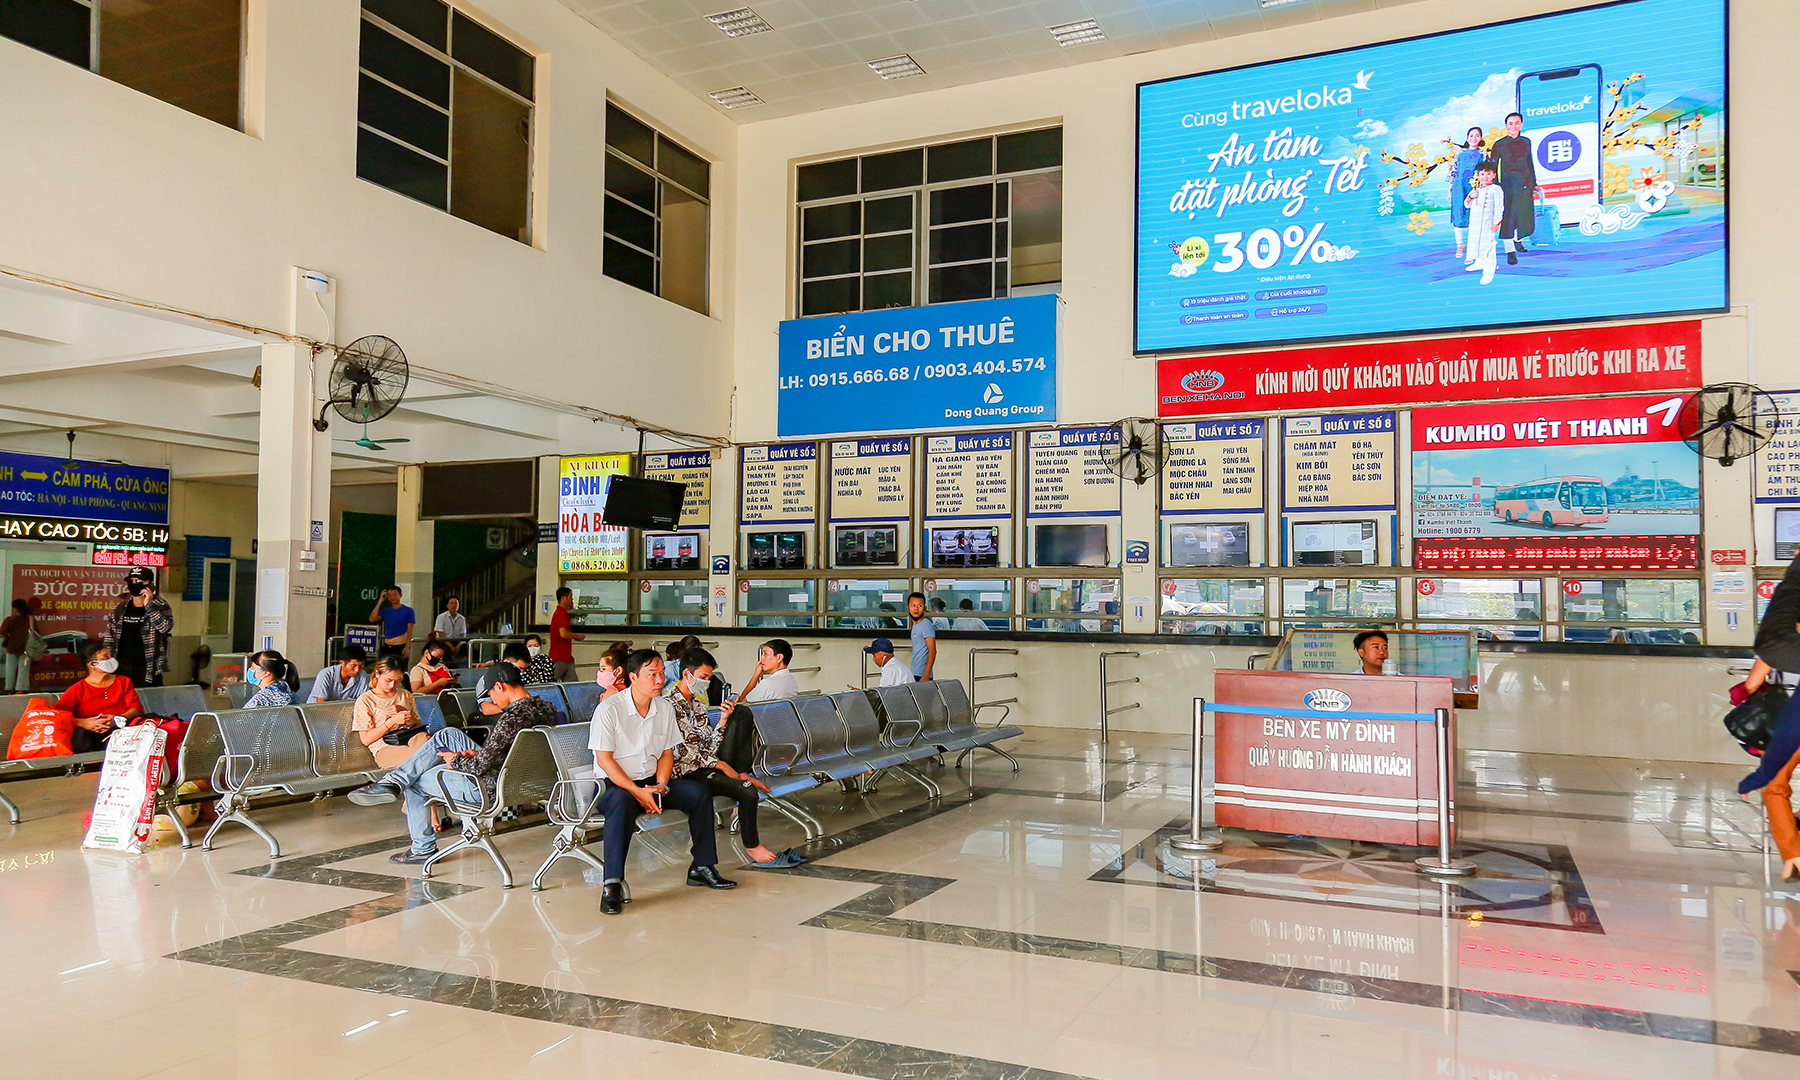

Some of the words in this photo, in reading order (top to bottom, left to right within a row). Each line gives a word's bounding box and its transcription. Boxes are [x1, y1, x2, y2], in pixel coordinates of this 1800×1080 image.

[1182, 110, 1227, 128] Cùng
[1232, 85, 1352, 120] traveloka
[1527, 101, 1584, 116] traveloka
[1207, 132, 1257, 172] An
[1263, 126, 1323, 162] tâm
[1170, 178, 1220, 219] đặt
[1217, 169, 1314, 217] phòng
[1319, 150, 1370, 194] Tết
[1212, 222, 1332, 272] 30%
[807, 325, 864, 360] BIỂN
[874, 329, 931, 354] CHO
[939, 316, 1014, 348] THUÊ
[780, 376, 803, 390] LH:
[809, 367, 909, 387] 0915.666.68
[924, 357, 1045, 379] 0903.404.574
[1256, 368, 1288, 395] KÍNH
[1293, 365, 1318, 393] MỜI
[1322, 363, 1350, 394] QUÝ
[1354, 361, 1401, 389] KHÁCH
[1406, 358, 1434, 385] VÀO
[1439, 352, 1478, 387] QUẦY
[1483, 357, 1518, 381] MUA
[1523, 351, 1541, 380] VÉ
[1547, 347, 1598, 378] TRƯỚC
[1603, 348, 1631, 374] KHI
[1637, 347, 1658, 373] RA
[1664, 345, 1686, 371] XE
[1190, 379, 1216, 389] HNB
[1187, 394, 1203, 402] XE
[945, 408, 972, 418] Dong
[975, 406, 1008, 417] Quang
[1011, 404, 1044, 416] Group
[1353, 418, 1365, 429] VÉ
[1368, 416, 1382, 428] SỐ
[1385, 419, 1391, 428] 8
[1087, 431, 1097, 442] VÉ
[1100, 429, 1111, 441] SỐ
[1114, 432, 1119, 440] 6
[1225, 425, 1236, 436] VÉ
[1240, 423, 1252, 435] SỐ
[1254, 425, 1260, 434] 7
[1426, 424, 1506, 444] KUMHO
[1513, 417, 1561, 442] VIỆT
[1567, 417, 1648, 438] THANH
[881, 442, 890, 452] VÉ
[892, 441, 902, 452] SỐ
[904, 443, 909, 451] 4
[981, 438, 990, 448] VÉ
[992, 436, 1003, 447] SỐ
[790, 448, 798, 457] VÉ
[800, 446, 810, 457] SỐ
[569, 462, 582, 471] XE
[585, 458, 619, 470] KHÁCH
[143, 477, 167, 494] ÔNG
[562, 472, 599, 496] BÌNH
[562, 508, 589, 533] HÒA
[38, 522, 79, 538] CAO
[83, 523, 119, 540] TỐC
[123, 528, 147, 542] 5B:
[571, 560, 625, 570] 0868.520.628
[34, 580, 77, 596] ĐỨC
[644, 582, 649, 591] 2
[742, 582, 749, 591] 3
[831, 581, 838, 591] 4
[927, 581, 935, 591] 5
[1030, 581, 1038, 591] 6
[1165, 581, 1174, 593] 7
[1422, 582, 1431, 593] 9
[1566, 582, 1581, 593] 10
[1760, 585, 1774, 594] 11
[41, 601, 52, 609] XE
[1300, 719, 1322, 739] XE
[1326, 718, 1351, 740] MỸ
[1355, 719, 1396, 743] ĐÌNH
[1341, 750, 1372, 774] HÀNH
[1374, 752, 1412, 777] KHÁCH
